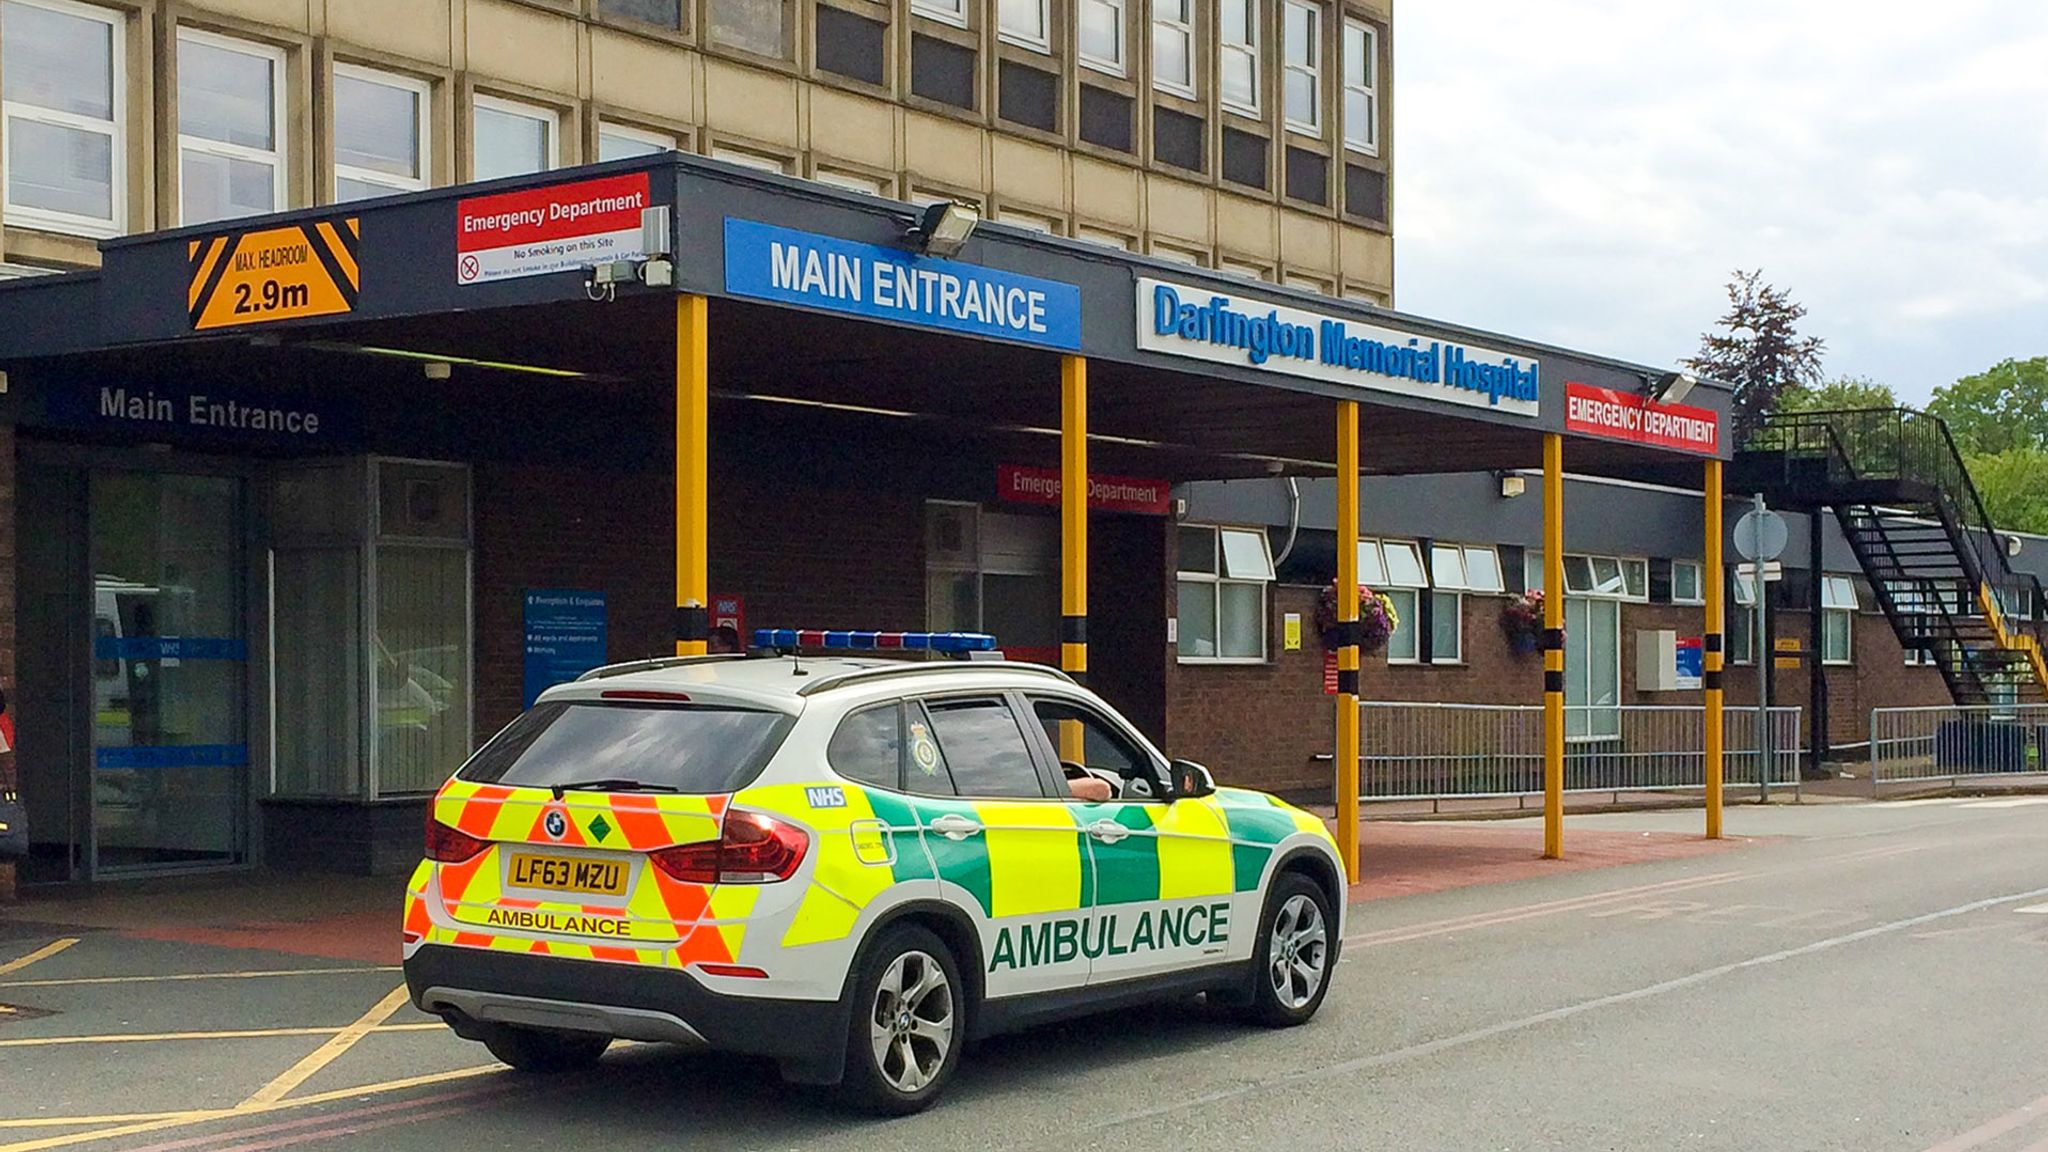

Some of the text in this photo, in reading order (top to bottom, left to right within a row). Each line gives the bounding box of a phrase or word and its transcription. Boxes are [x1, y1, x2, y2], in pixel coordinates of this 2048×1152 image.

[464, 191, 643, 232] Emergency Department
[258, 244, 308, 268] HEADROOM
[514, 238, 614, 260] No Smoking on this Site
[234, 280, 309, 314] 2.9m
[770, 242, 1047, 333] MAIN ENTRANCE
[1153, 284, 1538, 405] Darlington Memorial Hospital
[100, 387, 319, 434] Main Entrance
[1568, 396, 1715, 444] EMERGENCY DEPARTMENT
[1013, 471, 1061, 498] Emerge
[807, 787, 846, 807] NHS
[515, 858, 619, 890] LF63 MZU
[487, 908, 631, 936] AMBULANCE
[988, 902, 1230, 973] AMBULANCE
